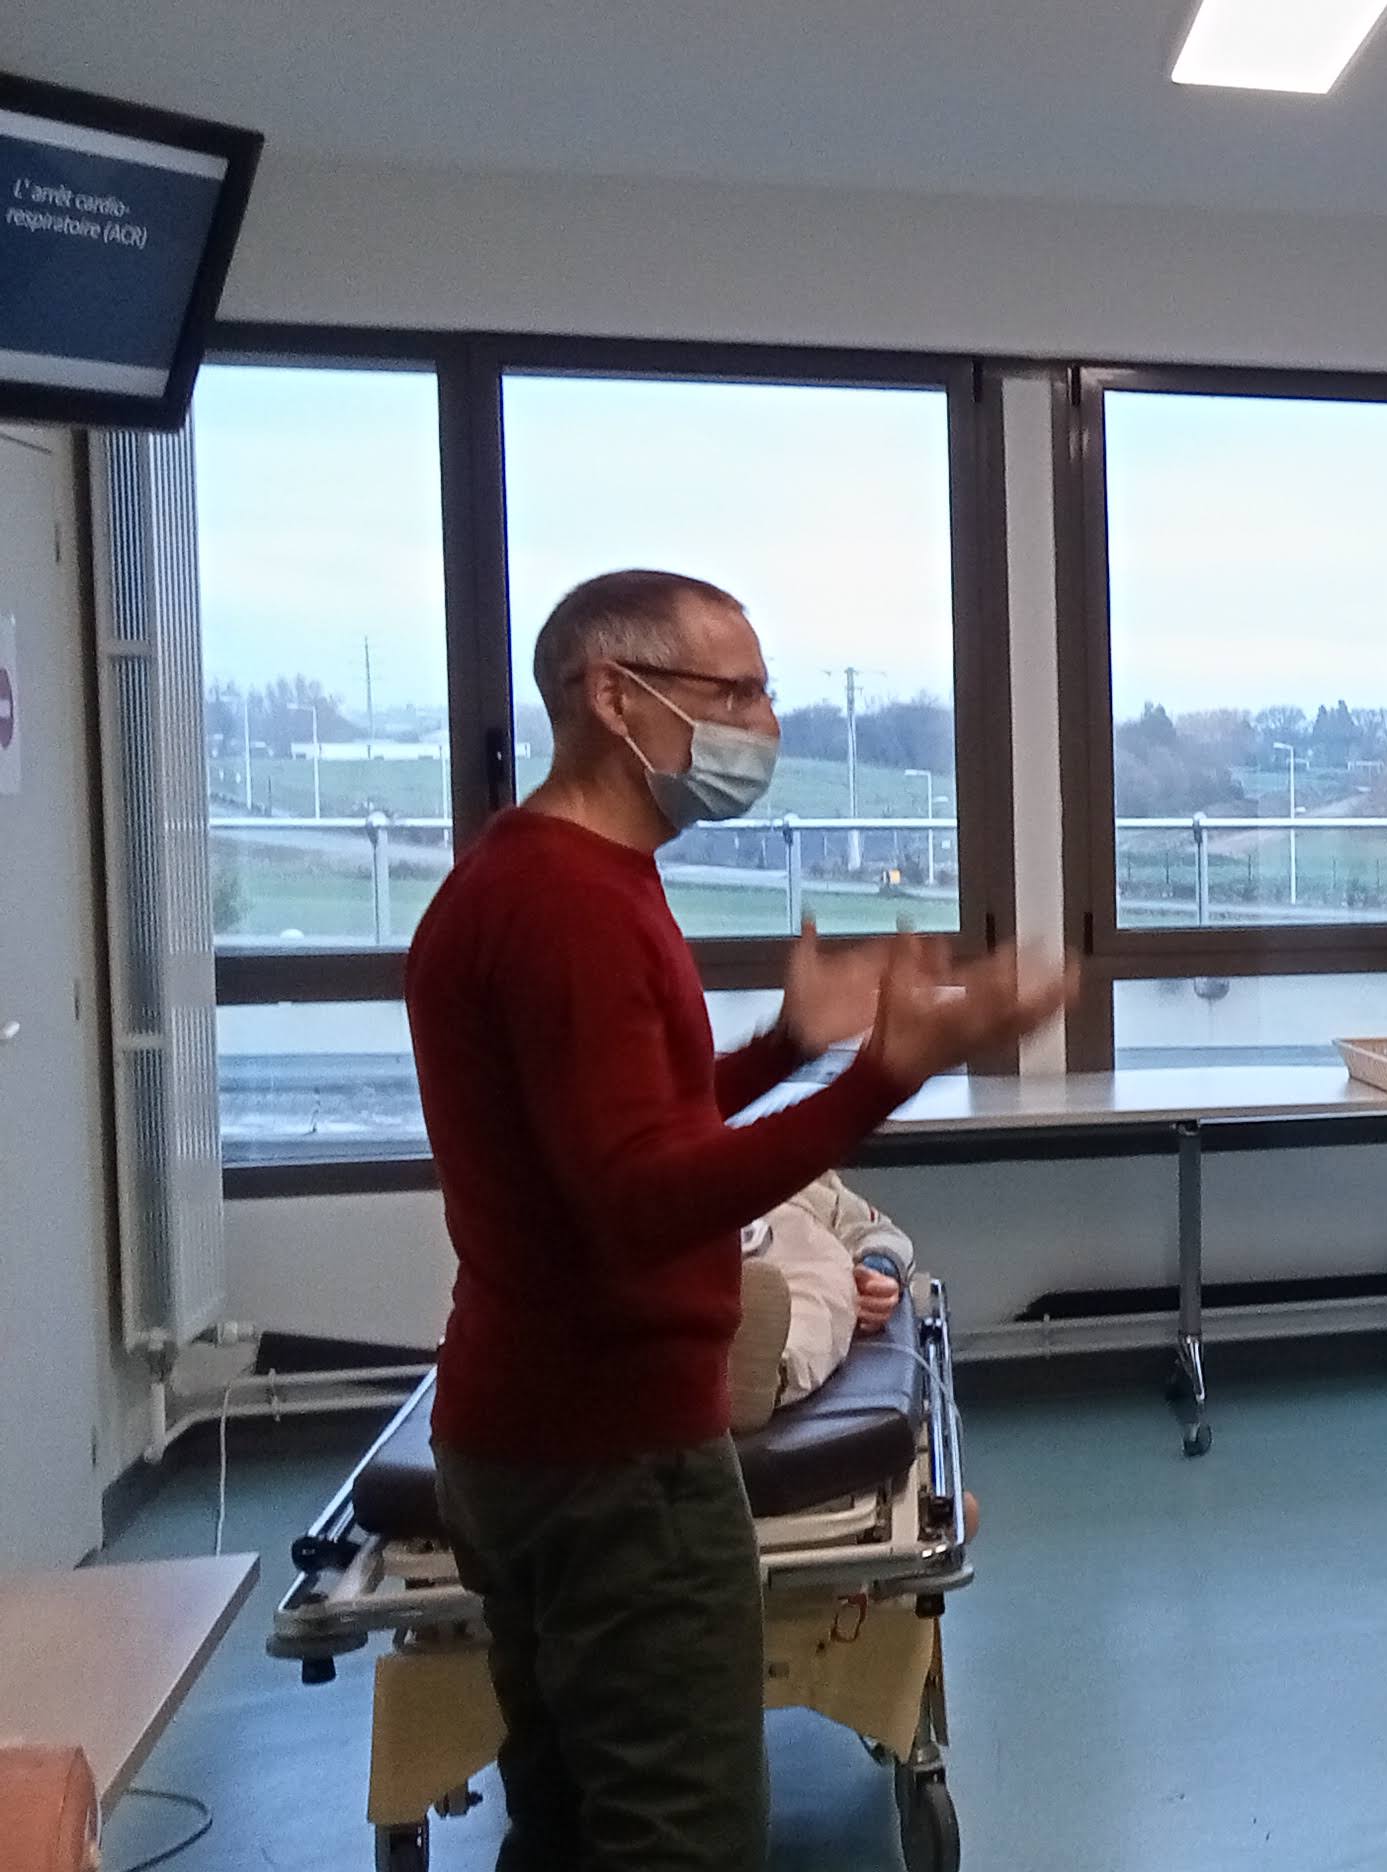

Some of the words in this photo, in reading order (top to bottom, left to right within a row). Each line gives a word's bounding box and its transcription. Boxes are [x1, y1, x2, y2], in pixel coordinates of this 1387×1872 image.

[75, 194, 130, 217] cardio-
[6, 207, 101, 239] respiratoire
[103, 220, 148, 250] (ACR)
